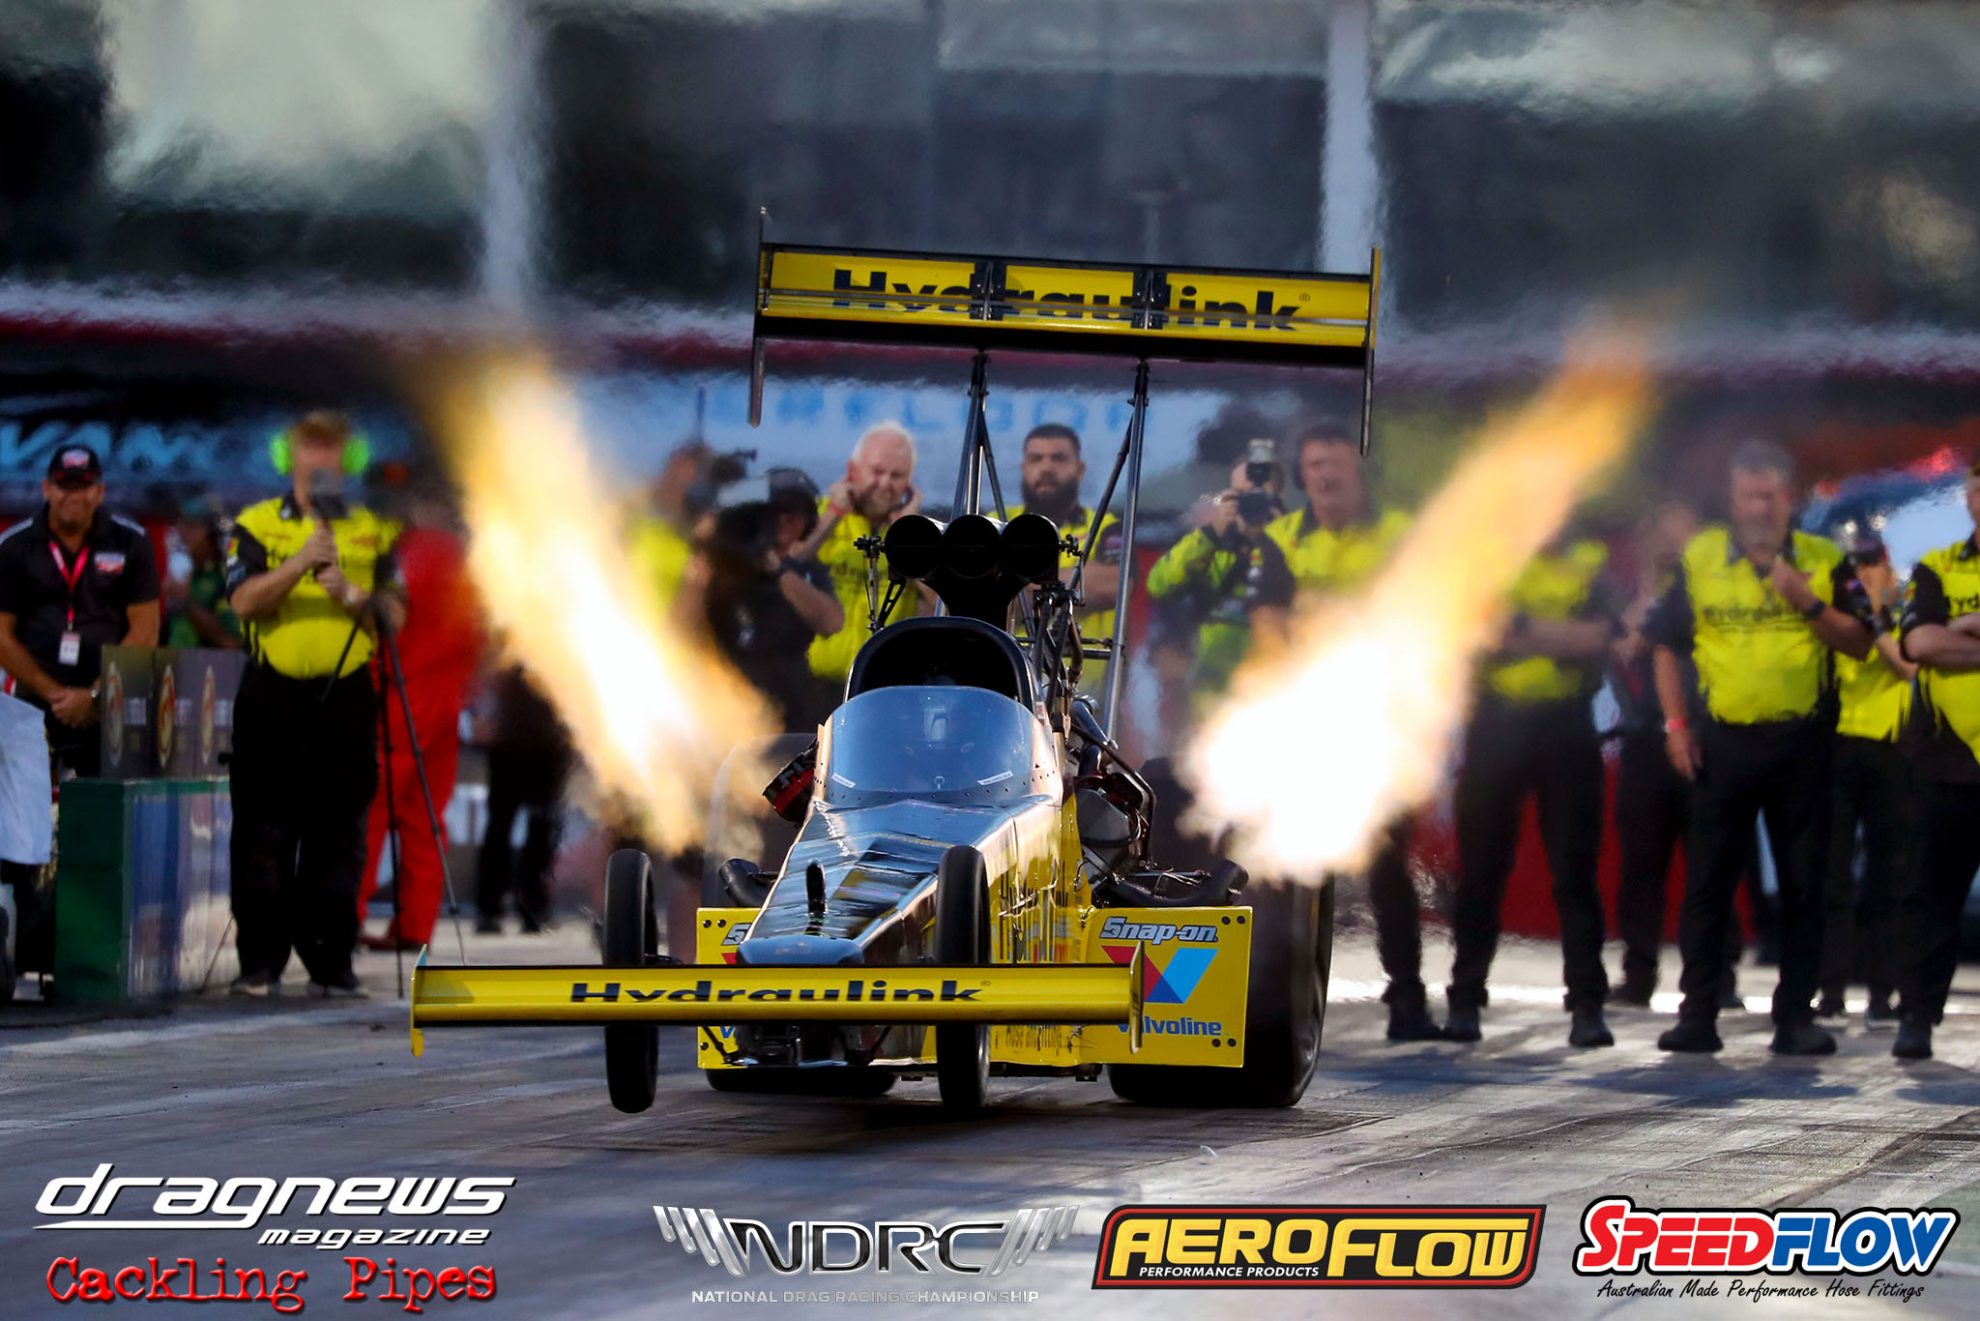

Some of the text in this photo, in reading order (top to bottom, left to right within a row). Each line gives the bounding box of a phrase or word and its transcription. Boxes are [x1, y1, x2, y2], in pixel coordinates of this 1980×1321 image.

[1100, 916, 1218, 944] Snap-on
[569, 980, 983, 1003] Hydraulink
[1117, 1016, 1222, 1036] lvoline
